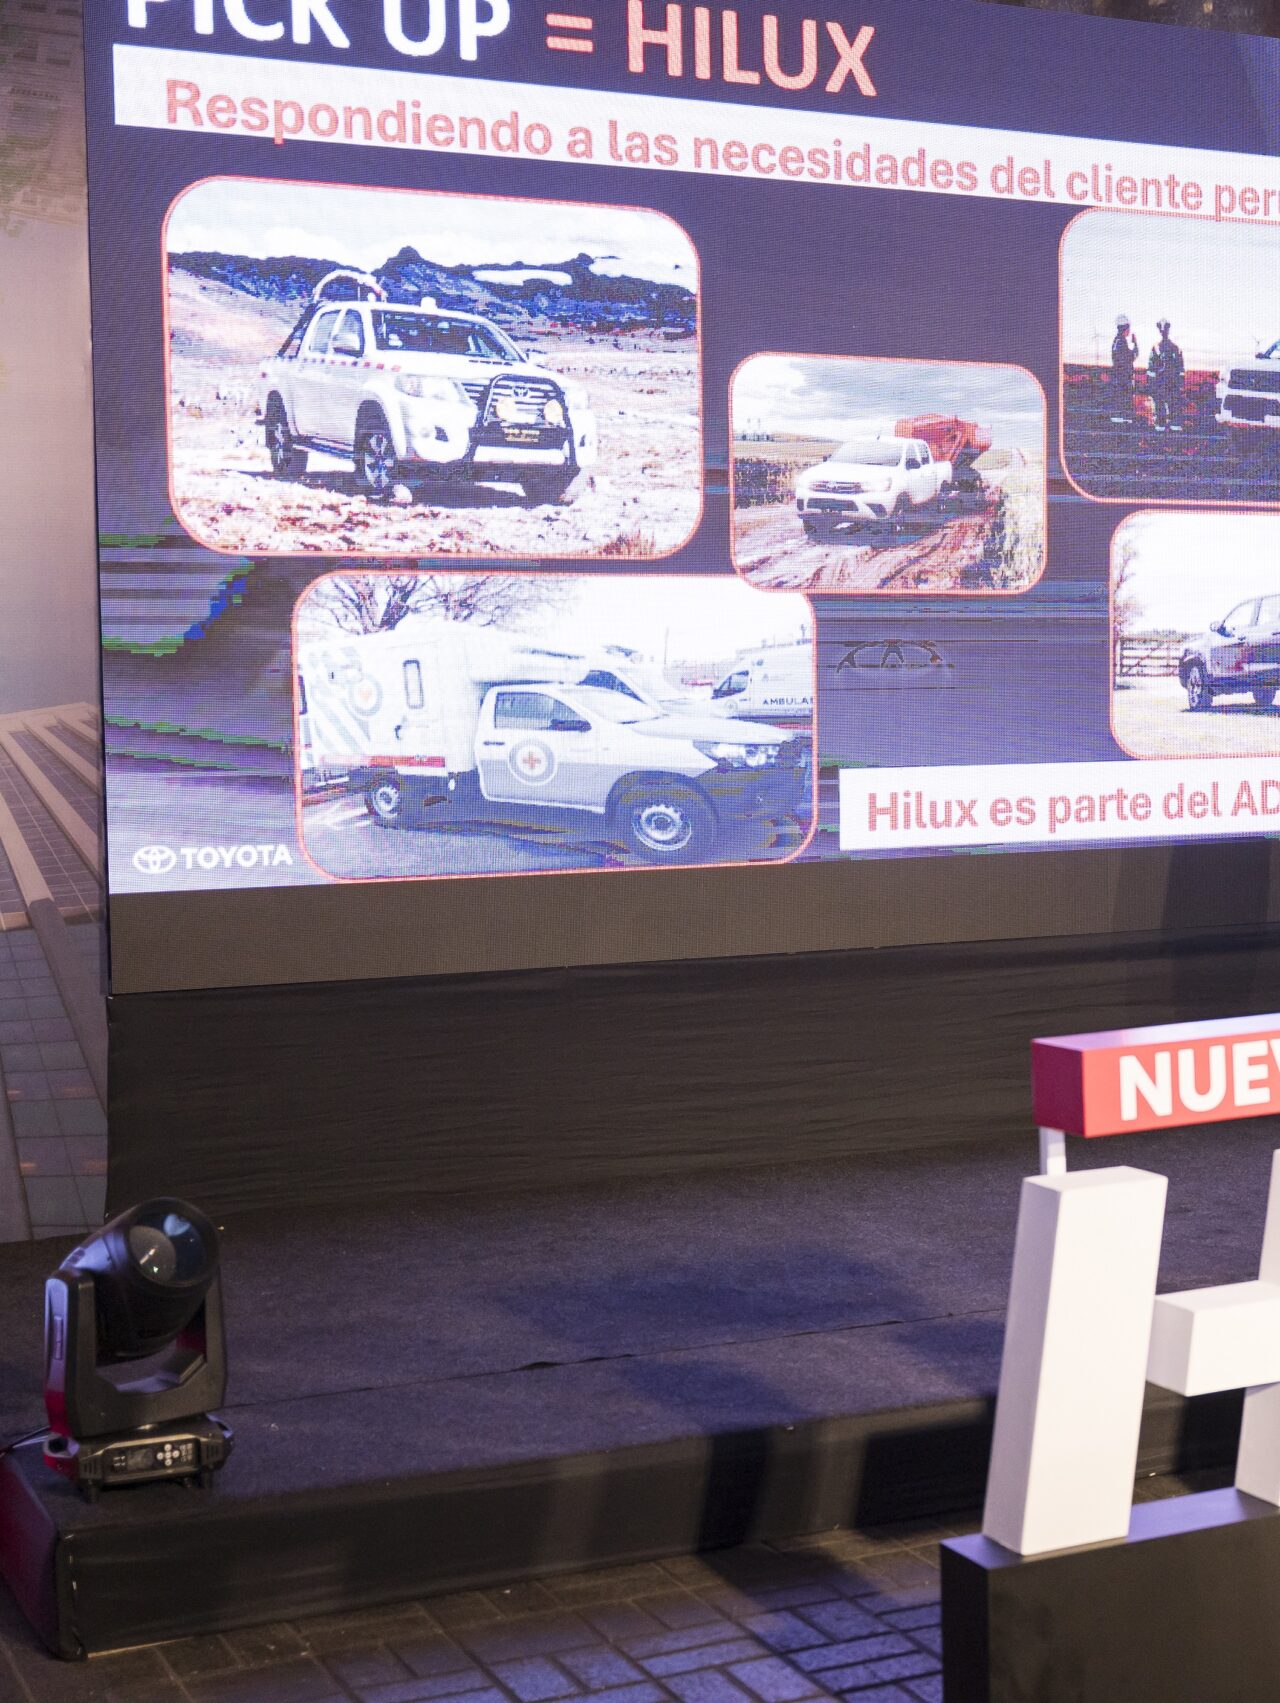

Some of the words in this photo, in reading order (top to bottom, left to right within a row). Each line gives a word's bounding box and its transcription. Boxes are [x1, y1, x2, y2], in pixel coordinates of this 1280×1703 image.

[382, 0, 511, 62] UP
[626, 0, 878, 98] HILUX
[165, 77, 553, 157] Respondiendo
[566, 126, 594, 160] a
[607, 118, 680, 166] las
[692, 136, 978, 193] necesidades
[989, 155, 1054, 199] del
[1066, 162, 1203, 212] cliente
[866, 791, 979, 833] Hilux
[989, 796, 1036, 827] es
[1048, 786, 1152, 834] parte
[1162, 780, 1221, 820] del
[180, 843, 294, 870] TOYOTA
